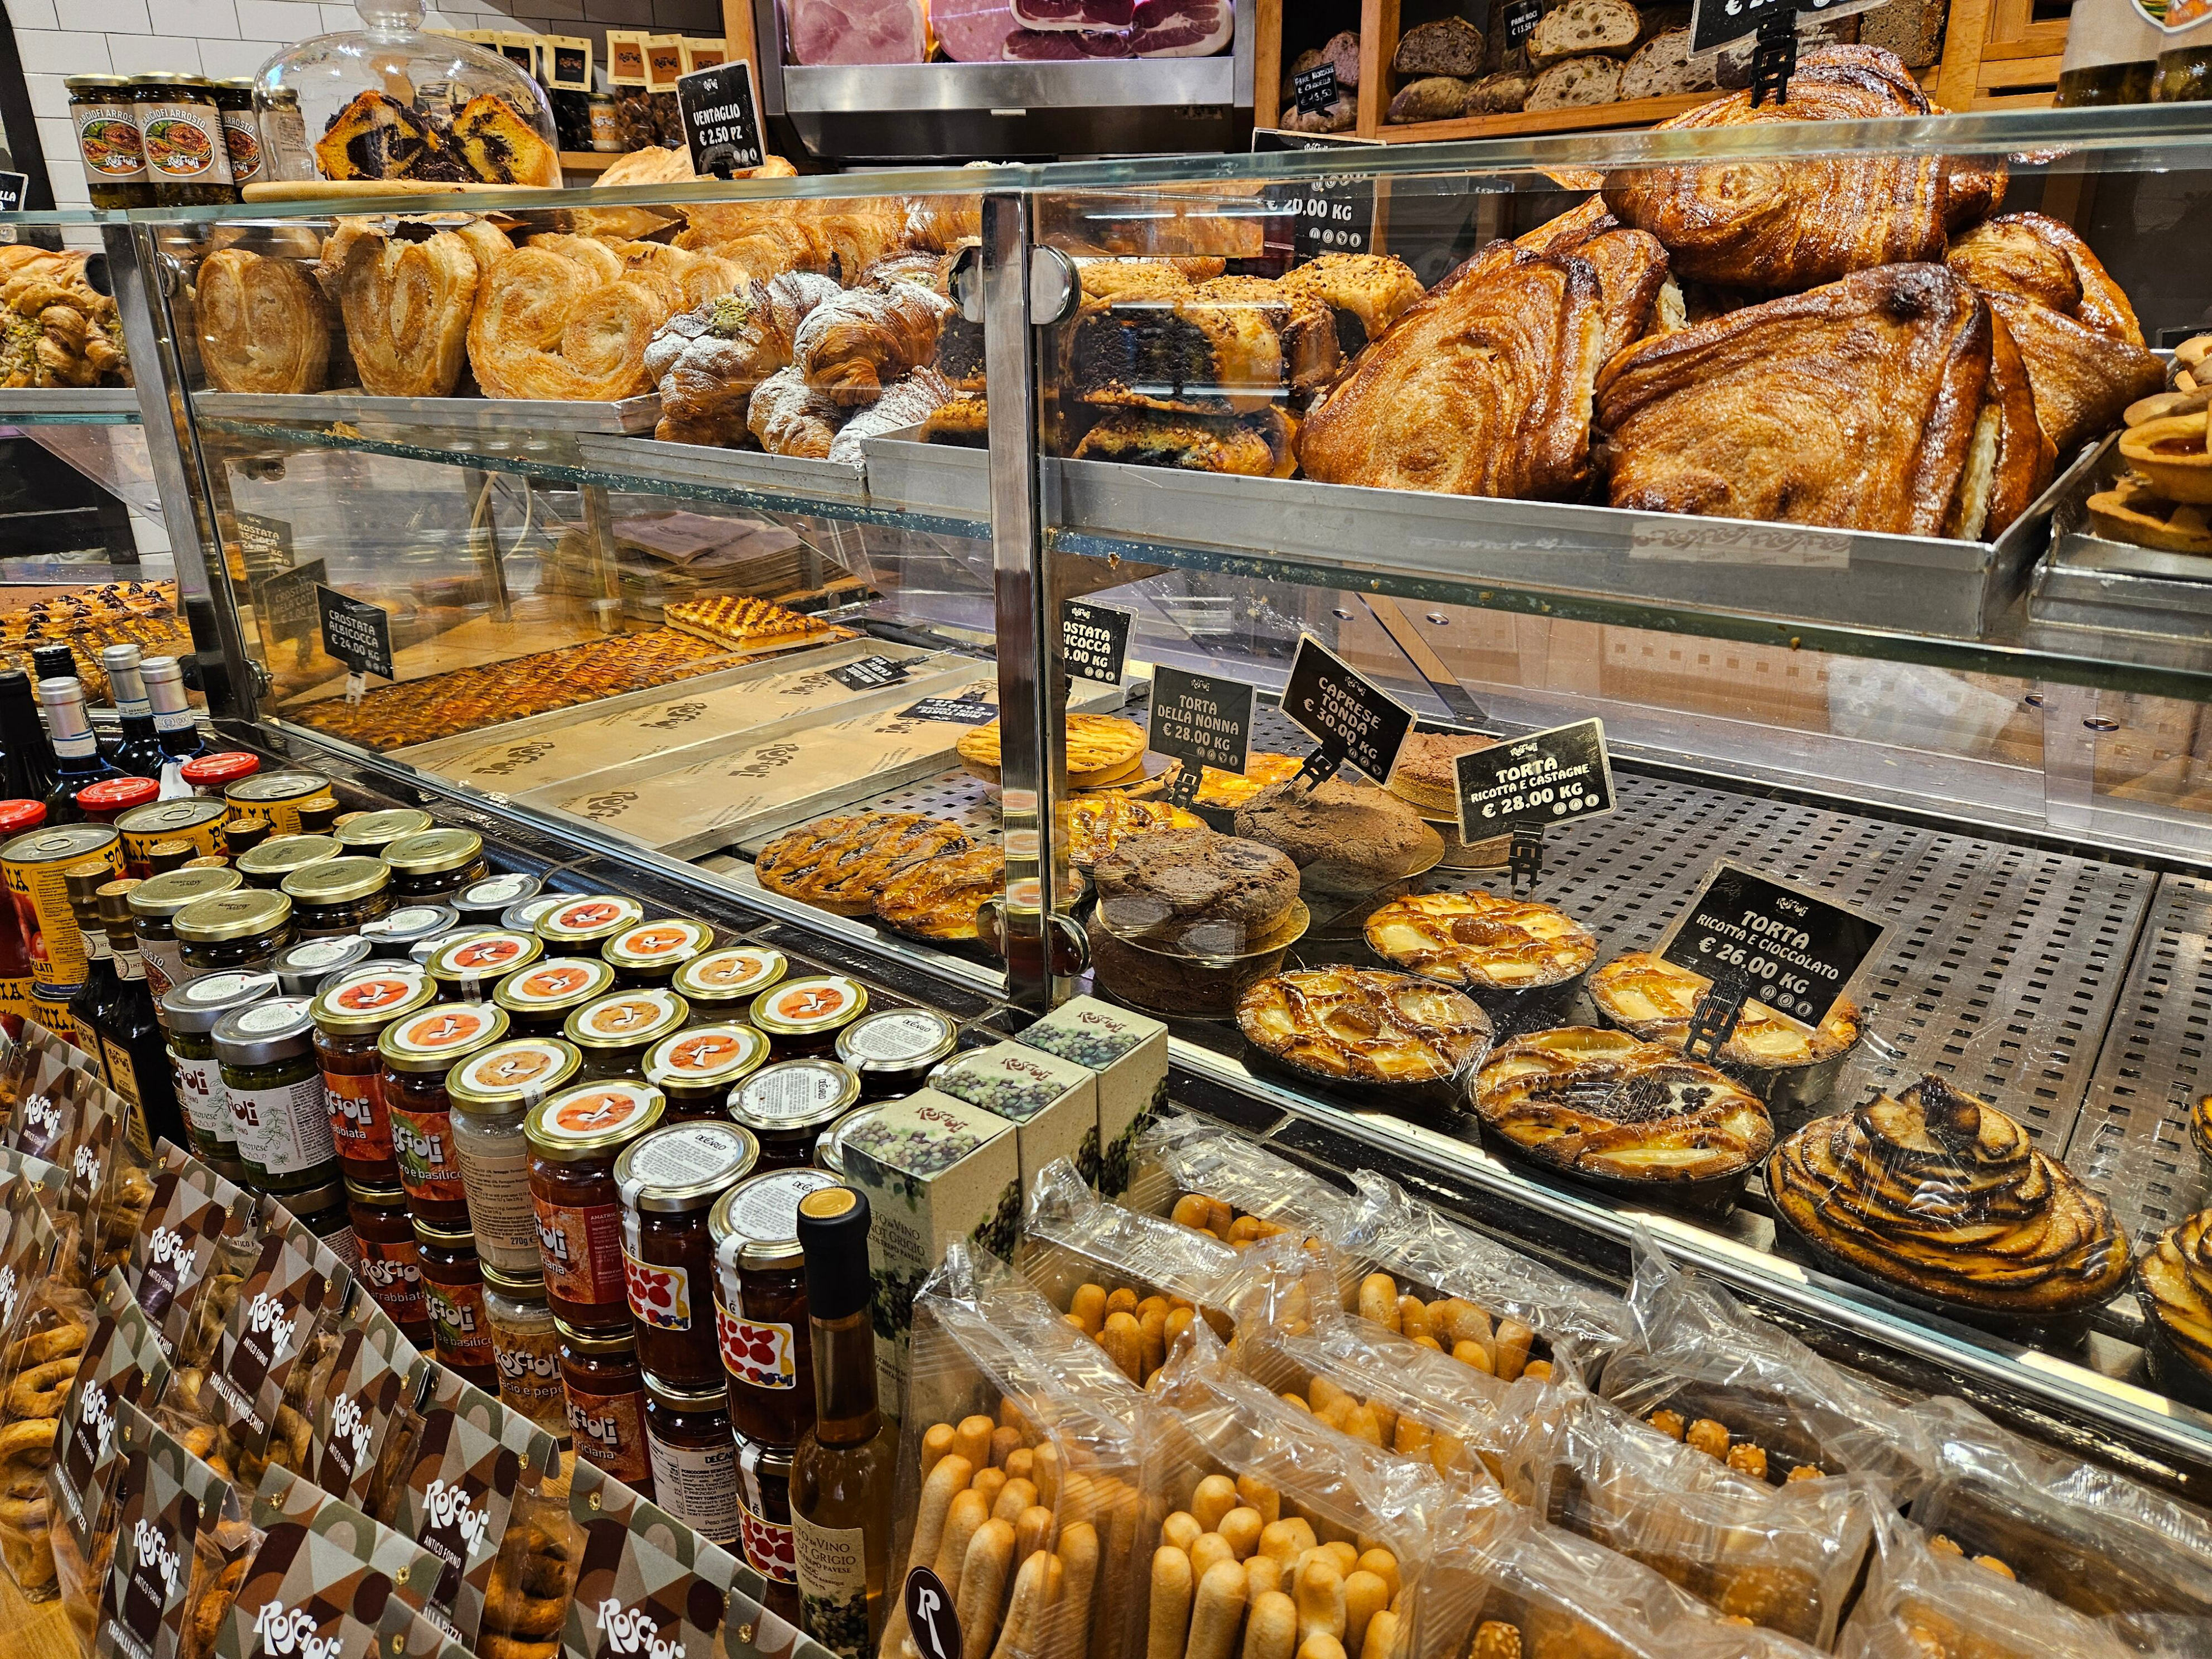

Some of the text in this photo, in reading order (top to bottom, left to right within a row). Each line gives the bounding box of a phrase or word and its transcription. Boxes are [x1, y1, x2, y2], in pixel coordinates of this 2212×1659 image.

[79, 109, 136, 127] CARCIOFI ARROS
[142, 108, 206, 129] CARCIOFI ARROSTO
[693, 103, 741, 127] VENTAGLIO
[699, 125, 743, 146] € 2.50 PZ
[1332, 204, 1352, 221] KG
[237, 522, 279, 541] ROSTATA
[240, 532, 278, 547] ISCIOLA
[329, 610, 375, 636] CROSTATA
[329, 623, 379, 649] ALBICOCCA
[1063, 621, 1111, 642] OSTATA
[331, 634, 380, 662] € KG
[1063, 634, 1111, 654] ICOCCA
[1063, 648, 1109, 668] 4,00 KG
[1179, 695, 1217, 715] TORTA
[1318, 677, 1382, 730] CAPRESE
[1322, 693, 1368, 736] TONDA
[1158, 705, 1239, 735] DELLA NONNA
[1303, 698, 1378, 760] € KG
[1162, 722, 1230, 751] € 28,00 KG
[1471, 764, 1590, 803] RICOTTA E CASTAGNE
[1496, 757, 1558, 784] TORTA
[1481, 782, 1584, 819] € 28,00 KG
[1741, 910, 1811, 951] TORTA
[140, 946, 165, 967] ROSTO
[1695, 913, 1839, 981] RICOTTA E CIOCCOLATO
[1698, 937, 1810, 995] € 26,00 KG
[190, 1112, 218, 1121] enovese
[325, 1088, 372, 1125] scioli
[239, 1140, 268, 1152] enovese
[591, 1212, 617, 1221] AMATRIC
[894, 1219, 920, 1240] VINO
[883, 1250, 897, 1261] DOC
[889, 1231, 925, 1256] GRIGIO
[147, 1267, 174, 1294] ANTICO FORNO
[360, 1257, 420, 1287] Roscio
[242, 1337, 268, 1367] ANTICO FORNO
[209, 1371, 264, 1435] TARALLI AL FINOCCHIO
[523, 1387, 530, 1395] e
[423, 1535, 462, 1569] ANTICO FORNO
[811, 1548, 856, 1565] GRIGIO
[816, 1537, 850, 1552] VINO
[134, 1572, 162, 1609] ANTICO FORNO
[108, 1618, 131, 1656] TARALLI
[422, 1607, 463, 1645] ALLA PIZZA
